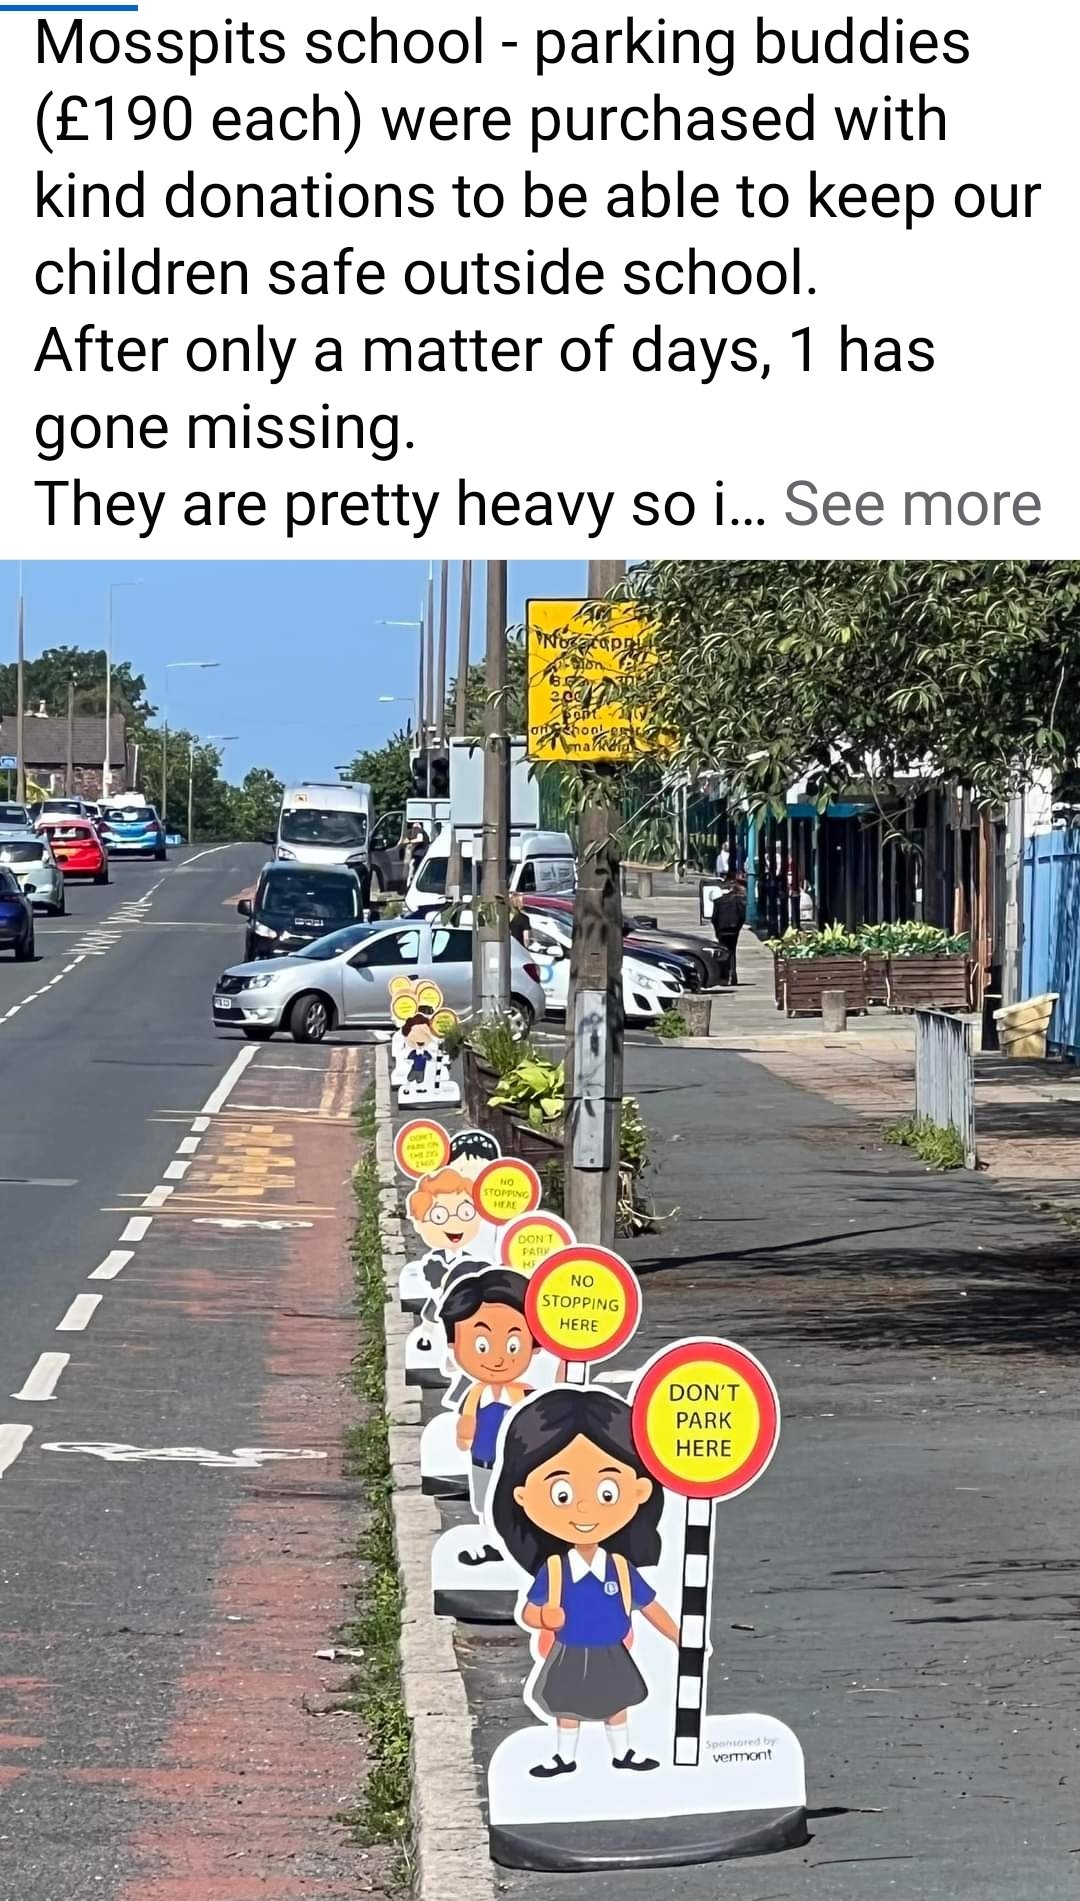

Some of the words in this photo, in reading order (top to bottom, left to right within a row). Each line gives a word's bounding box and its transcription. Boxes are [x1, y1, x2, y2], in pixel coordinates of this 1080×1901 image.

[500, 1177, 514, 1187] NO
[484, 1187, 529, 1200] STOPPING
[493, 1200, 518, 1210] HERE
[518, 1234, 553, 1245] DON'T
[571, 1274, 594, 1288] NO
[542, 1294, 619, 1312] STOPPING
[560, 1317, 599, 1332] HERE
[669, 1383, 740, 1402] DON'T
[676, 1411, 732, 1430] PARK
[676, 1439, 732, 1457] HERE
[705, 1737, 761, 1750] Sponsored
[712, 1748, 772, 1763] vermont
